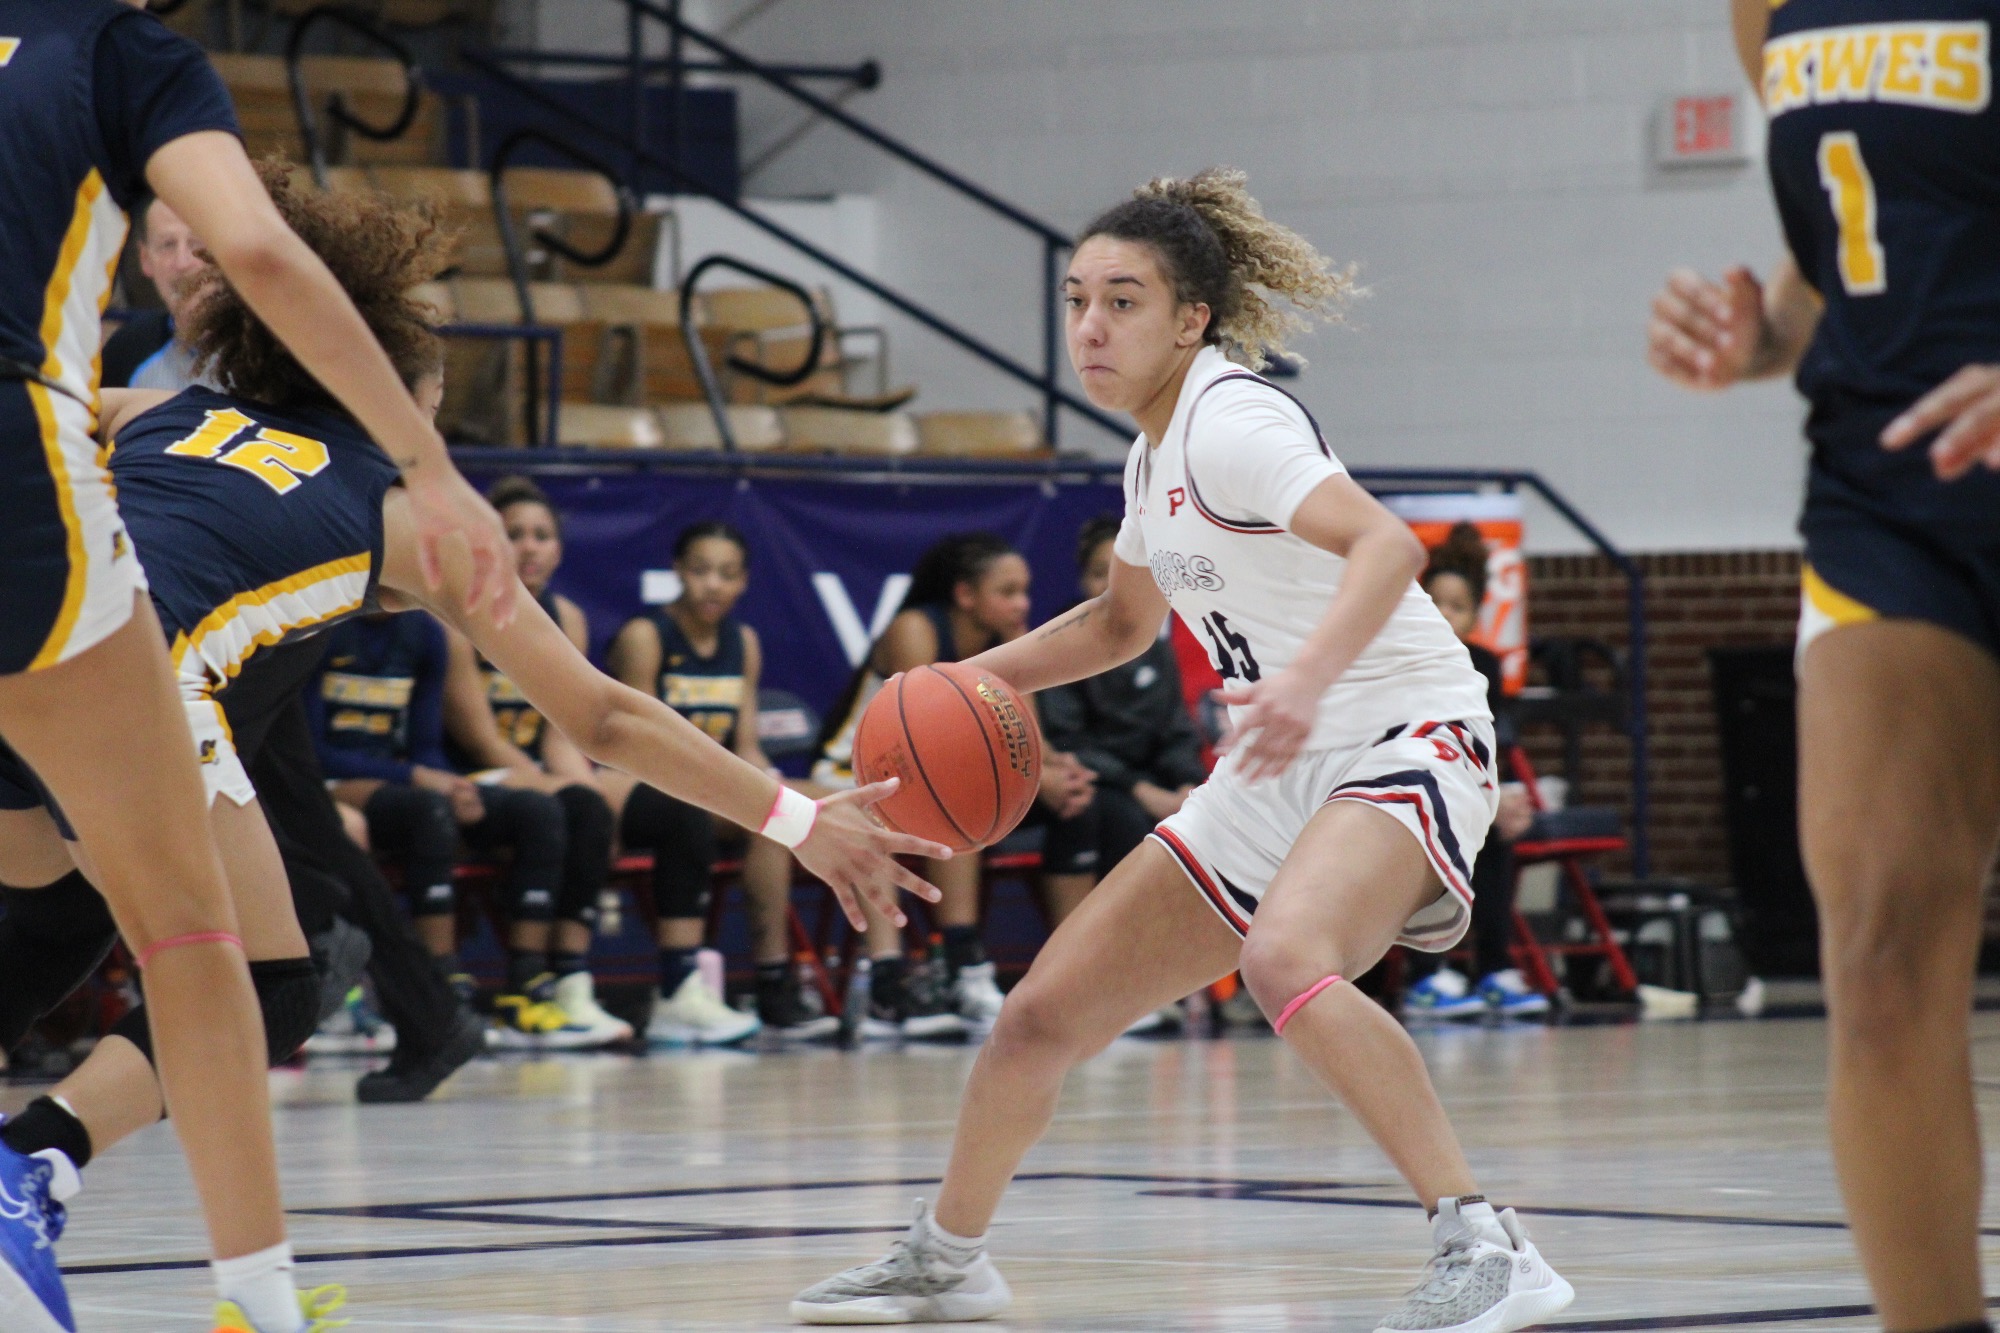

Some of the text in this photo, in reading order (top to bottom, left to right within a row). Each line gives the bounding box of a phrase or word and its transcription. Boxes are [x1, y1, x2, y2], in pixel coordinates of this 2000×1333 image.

[1817, 131, 1886, 296] 1
[164, 407, 331, 495] 12
[1168, 487, 1186, 517] P
[1202, 610, 1261, 683] 15
[978, 675, 1031, 778] LEGACY
